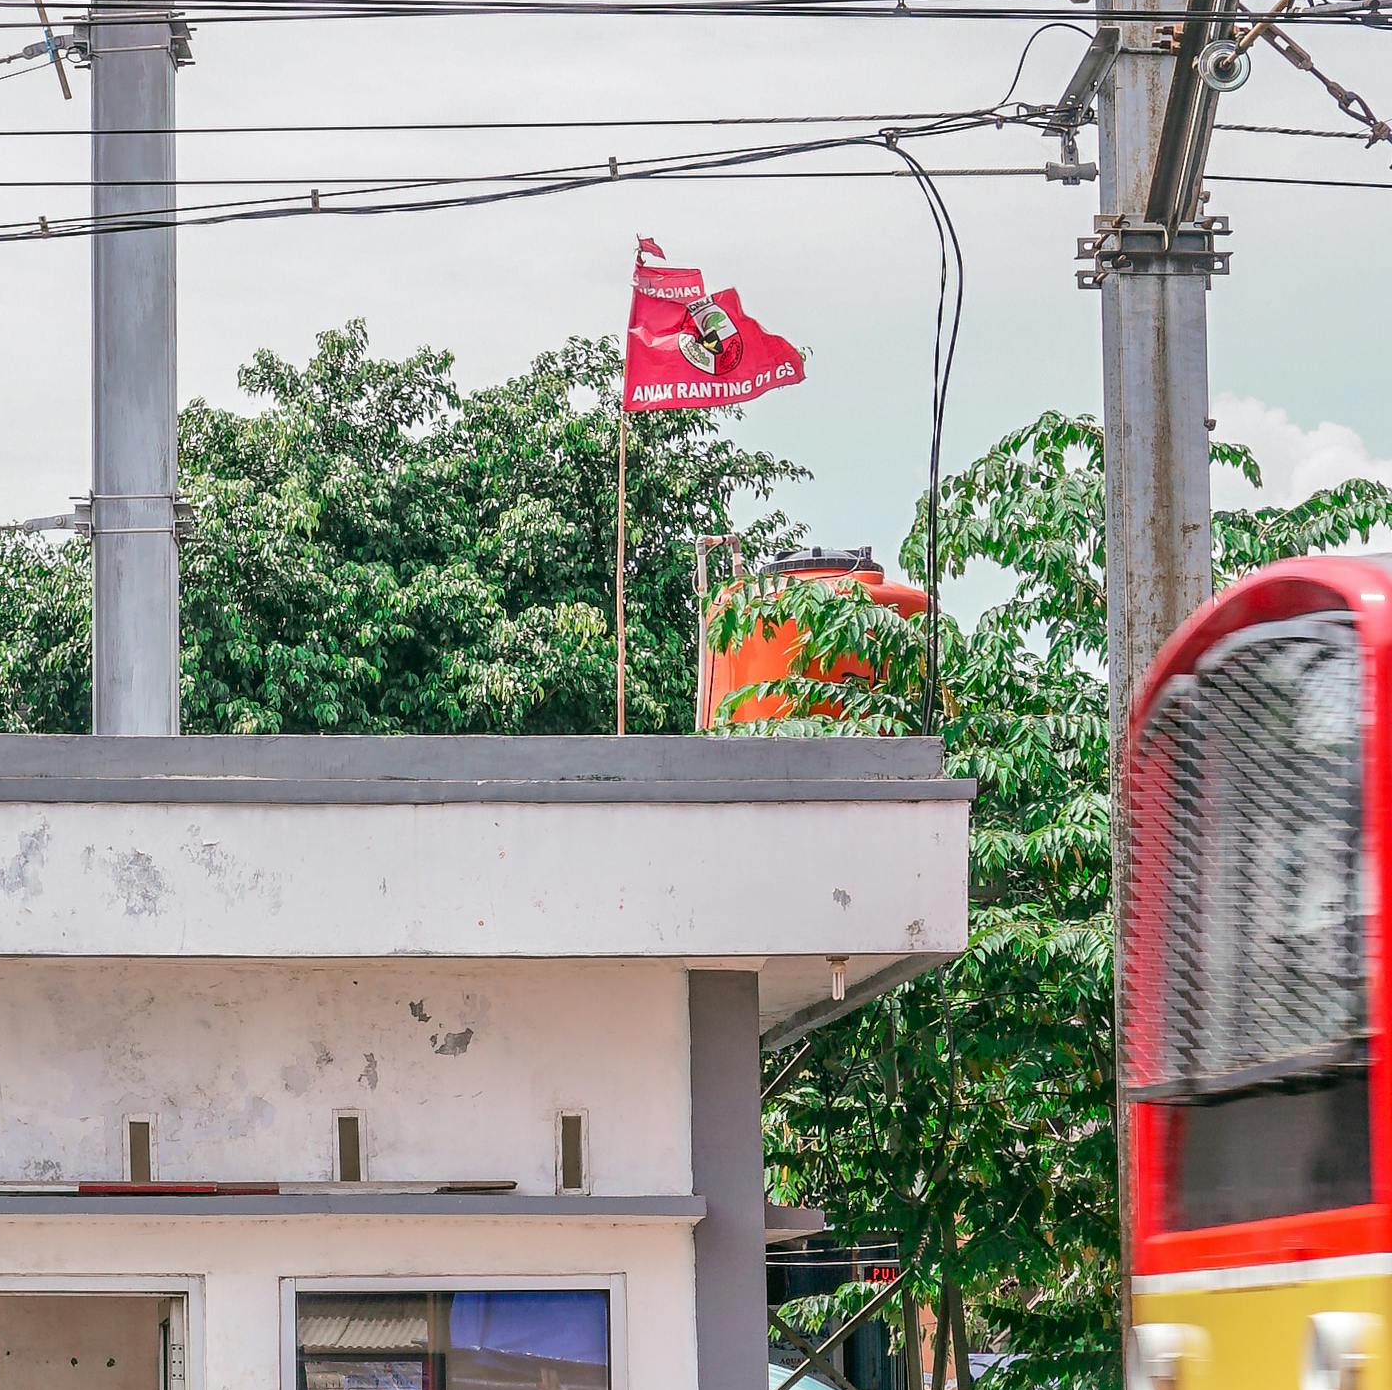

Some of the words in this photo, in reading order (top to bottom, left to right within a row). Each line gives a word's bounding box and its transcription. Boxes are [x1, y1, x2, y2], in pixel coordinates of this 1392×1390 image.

[632, 384, 674, 402] ANAK
[677, 380, 753, 399] RANTING
[755, 370, 771, 388] 01
[775, 361, 796, 380] GS
